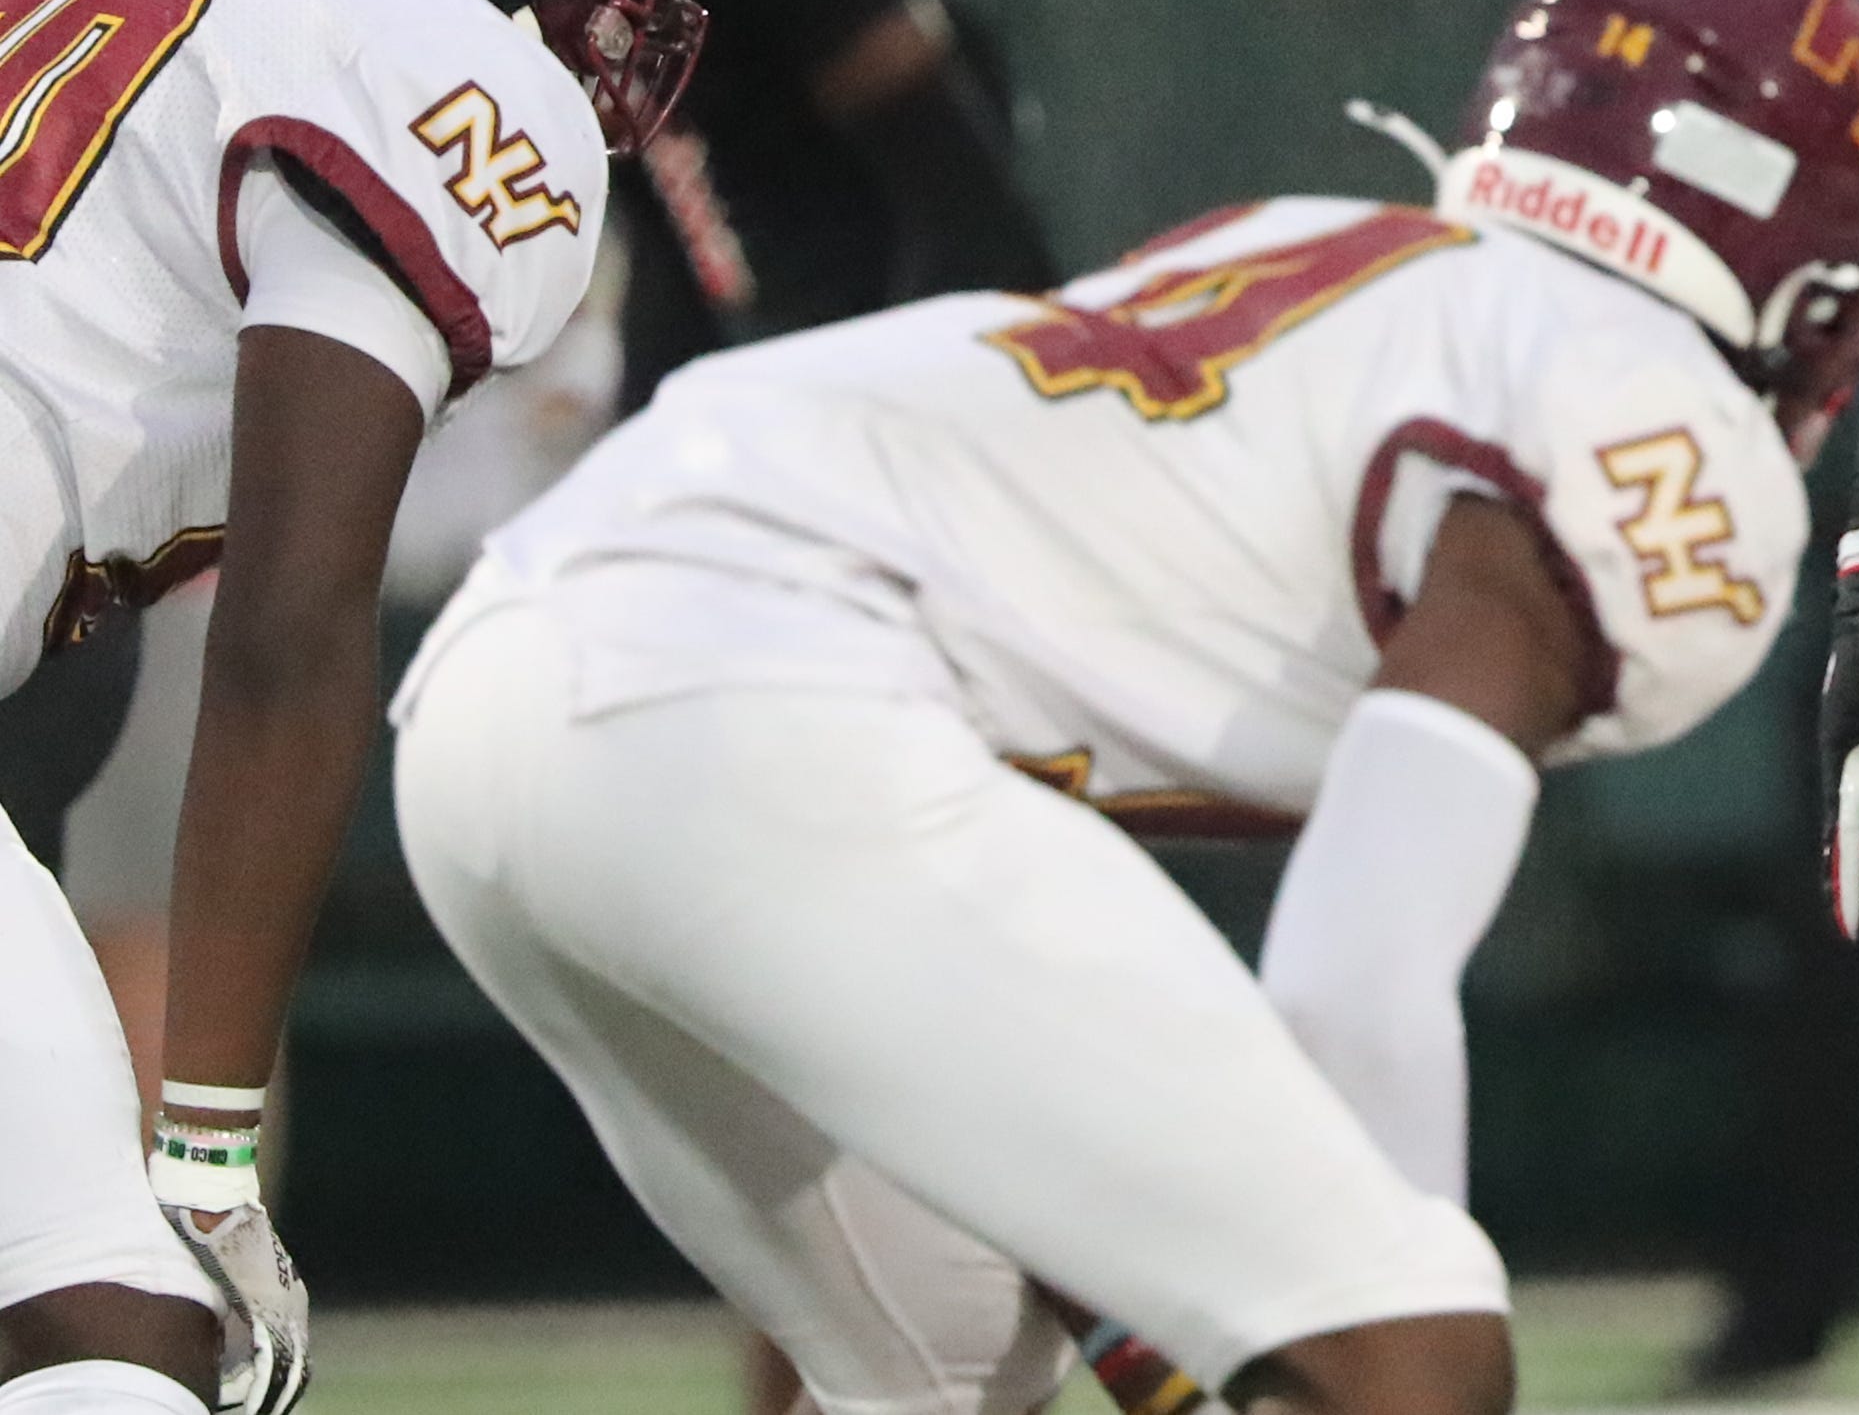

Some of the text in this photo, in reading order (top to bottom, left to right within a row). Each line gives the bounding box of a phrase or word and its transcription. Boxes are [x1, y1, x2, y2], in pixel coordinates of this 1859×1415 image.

[408, 79, 582, 253] NH
[1466, 160, 1670, 278] Riddell
[1595, 426, 1766, 627] NH
